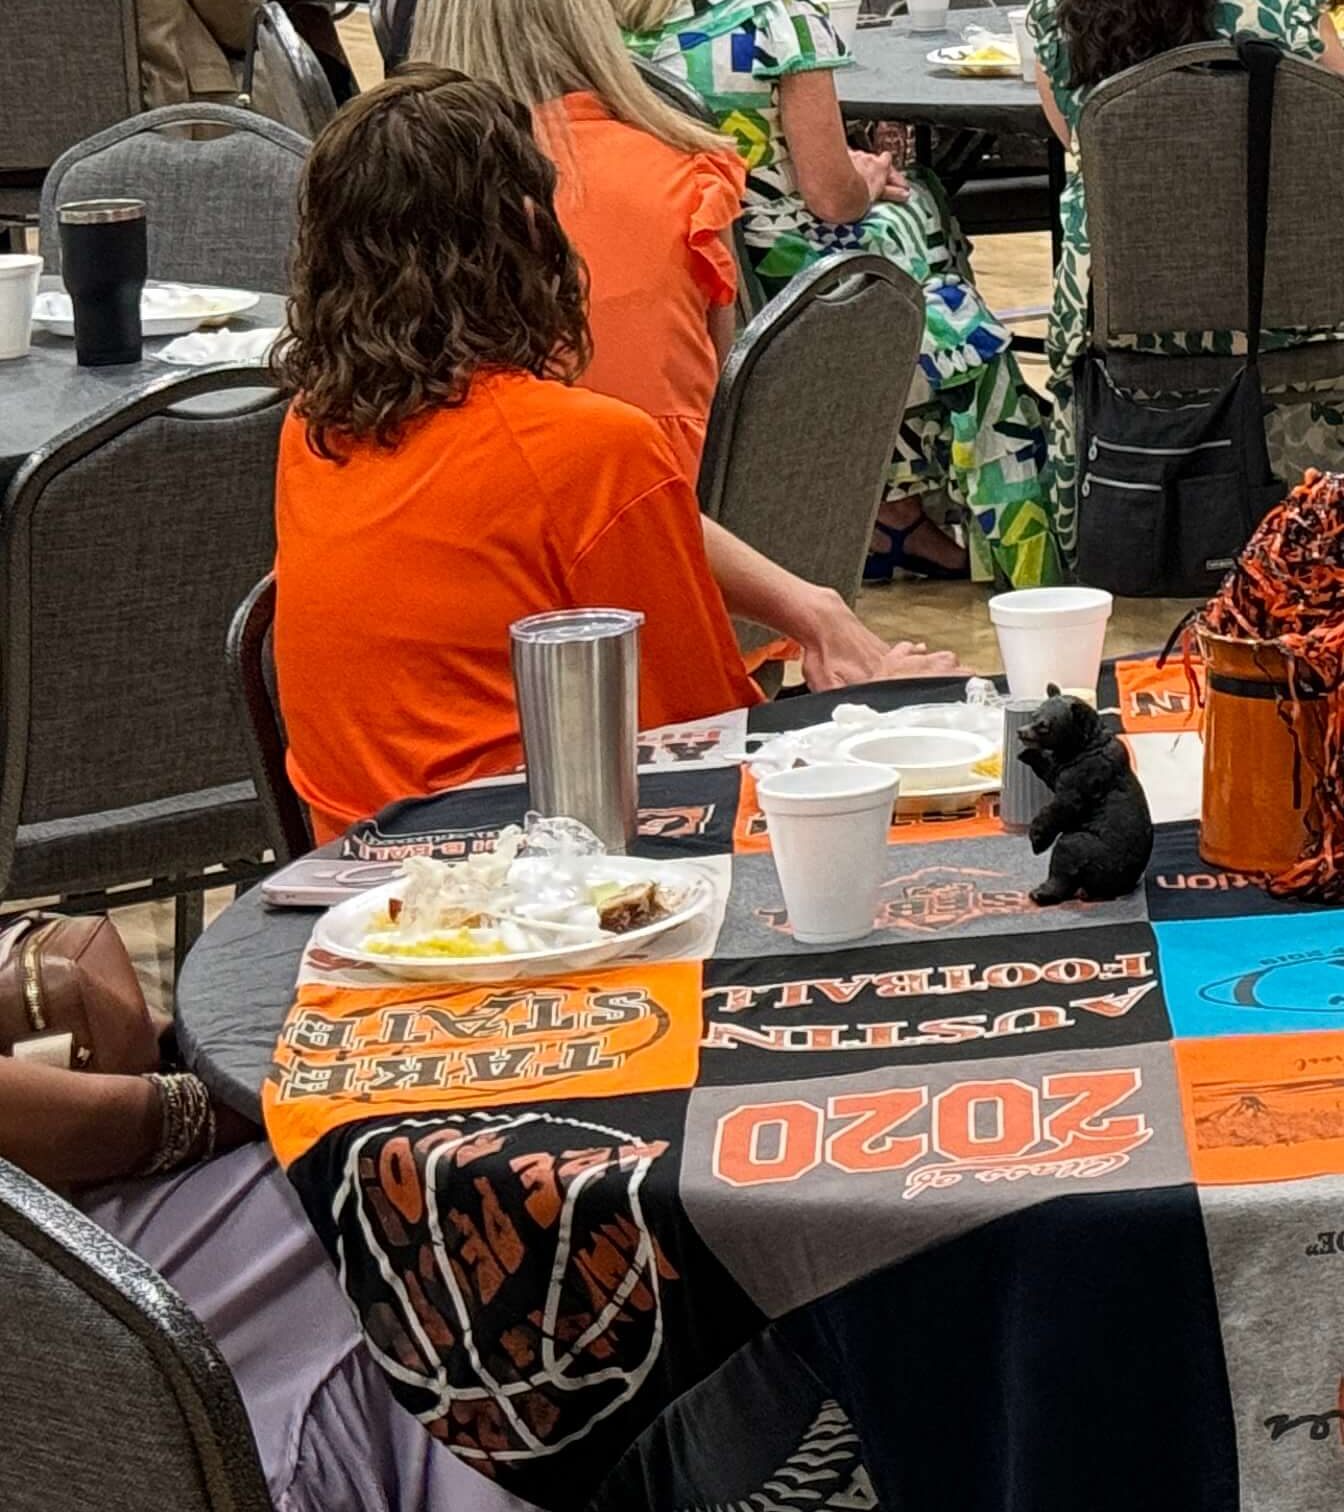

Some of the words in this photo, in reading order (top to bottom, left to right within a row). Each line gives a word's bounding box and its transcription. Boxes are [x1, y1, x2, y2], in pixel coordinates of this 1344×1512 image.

[704, 951, 1155, 1013] FOOTBALL
[284, 988, 652, 1054] STATE
[702, 979, 1160, 1053] AUSTIN
[274, 1038, 628, 1102] TAKE
[712, 1067, 1154, 1188] 2020
[902, 1162, 964, 1201] of
[978, 1152, 1131, 1184] Class
